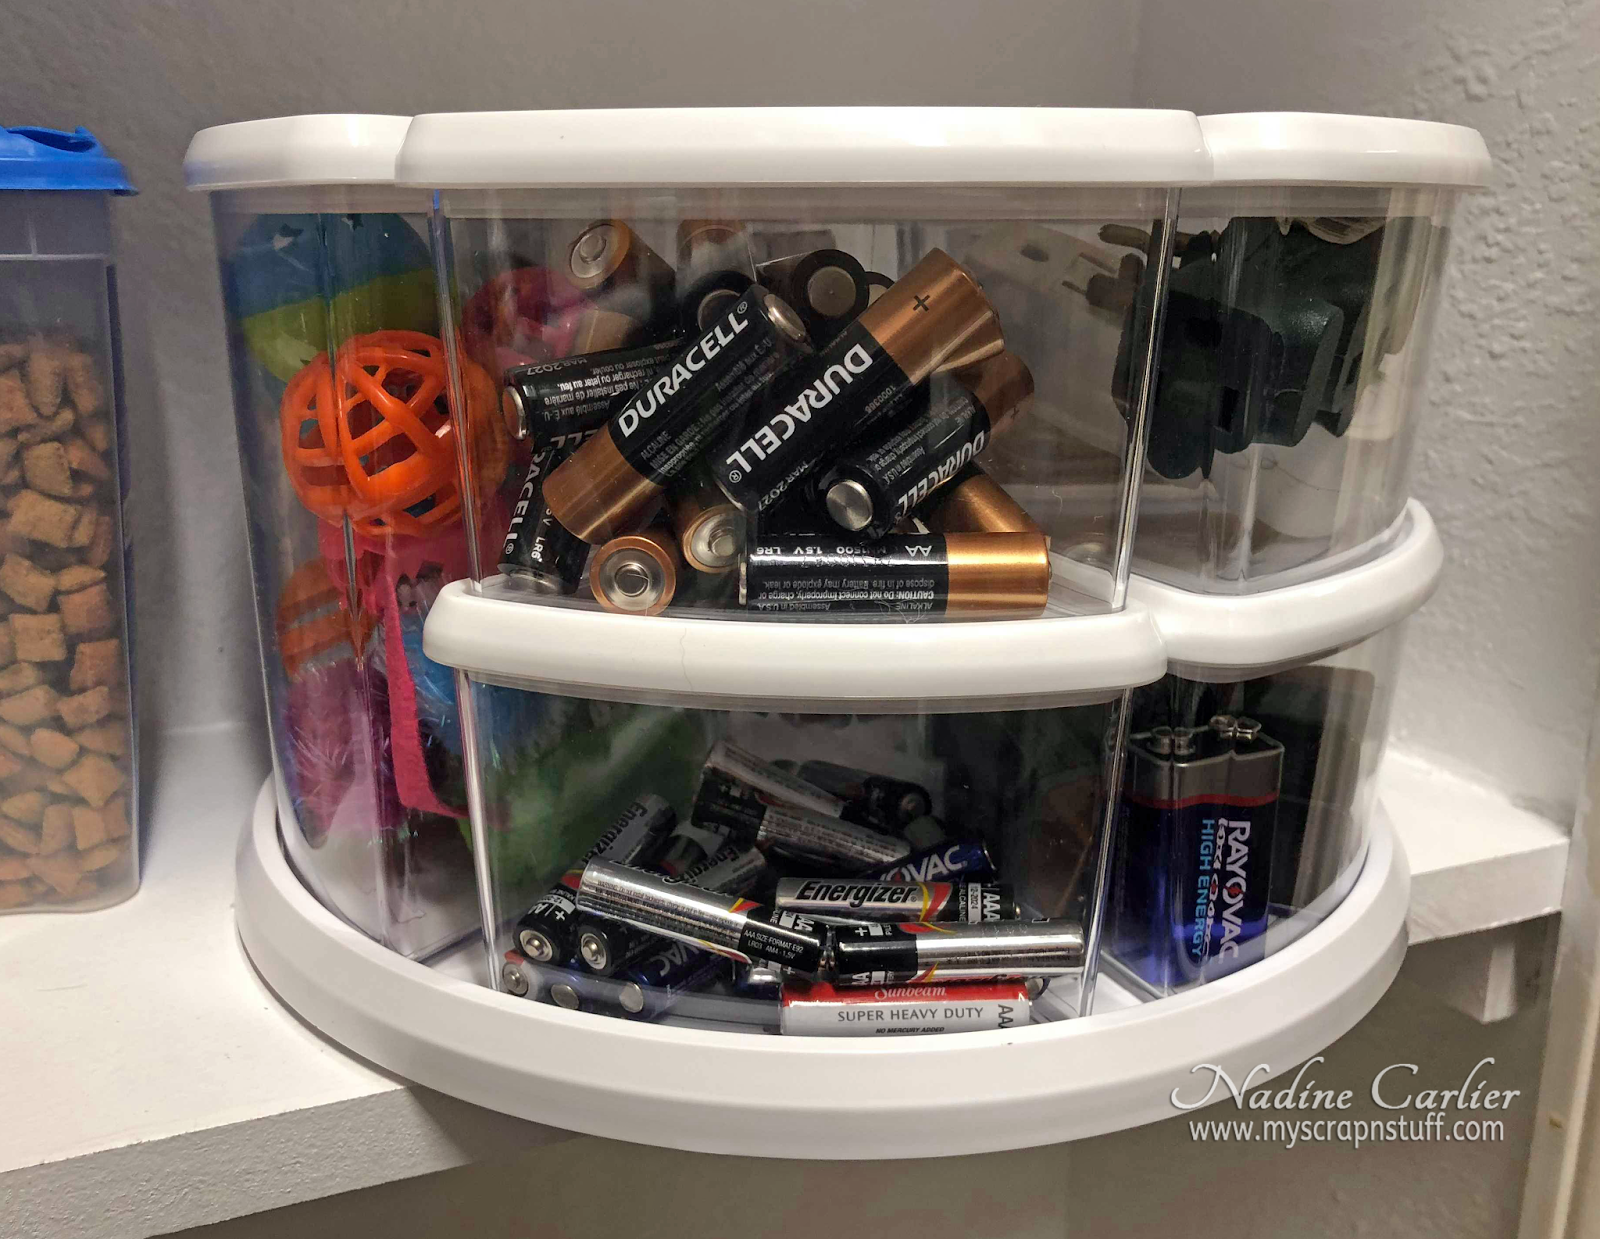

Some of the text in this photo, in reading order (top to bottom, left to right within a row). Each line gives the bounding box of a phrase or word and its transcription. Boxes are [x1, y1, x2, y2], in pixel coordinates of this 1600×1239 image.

[525, 361, 562, 375] 2027
[617, 311, 751, 437] DURACELL
[723, 342, 874, 479] DURACELL
[753, 461, 809, 512] MAR 2027
[529, 535, 546, 561] LR6
[755, 546, 780, 555] LR6
[904, 544, 932, 557] AA
[792, 578, 821, 589] explode
[822, 578, 839, 588] may
[768, 590, 794, 600] charge
[838, 591, 868, 600] connect
[870, 591, 880, 600] not
[883, 591, 894, 599] Do
[795, 880, 918, 907] Energizer
[1191, 819, 1214, 956] HIGH ENERGY
[1218, 819, 1250, 964] RAYOVAC
[743, 928, 756, 938] AAA
[837, 1006, 983, 1021] SUPER HEAVY DUTY
[997, 1004, 1013, 1028] AA
